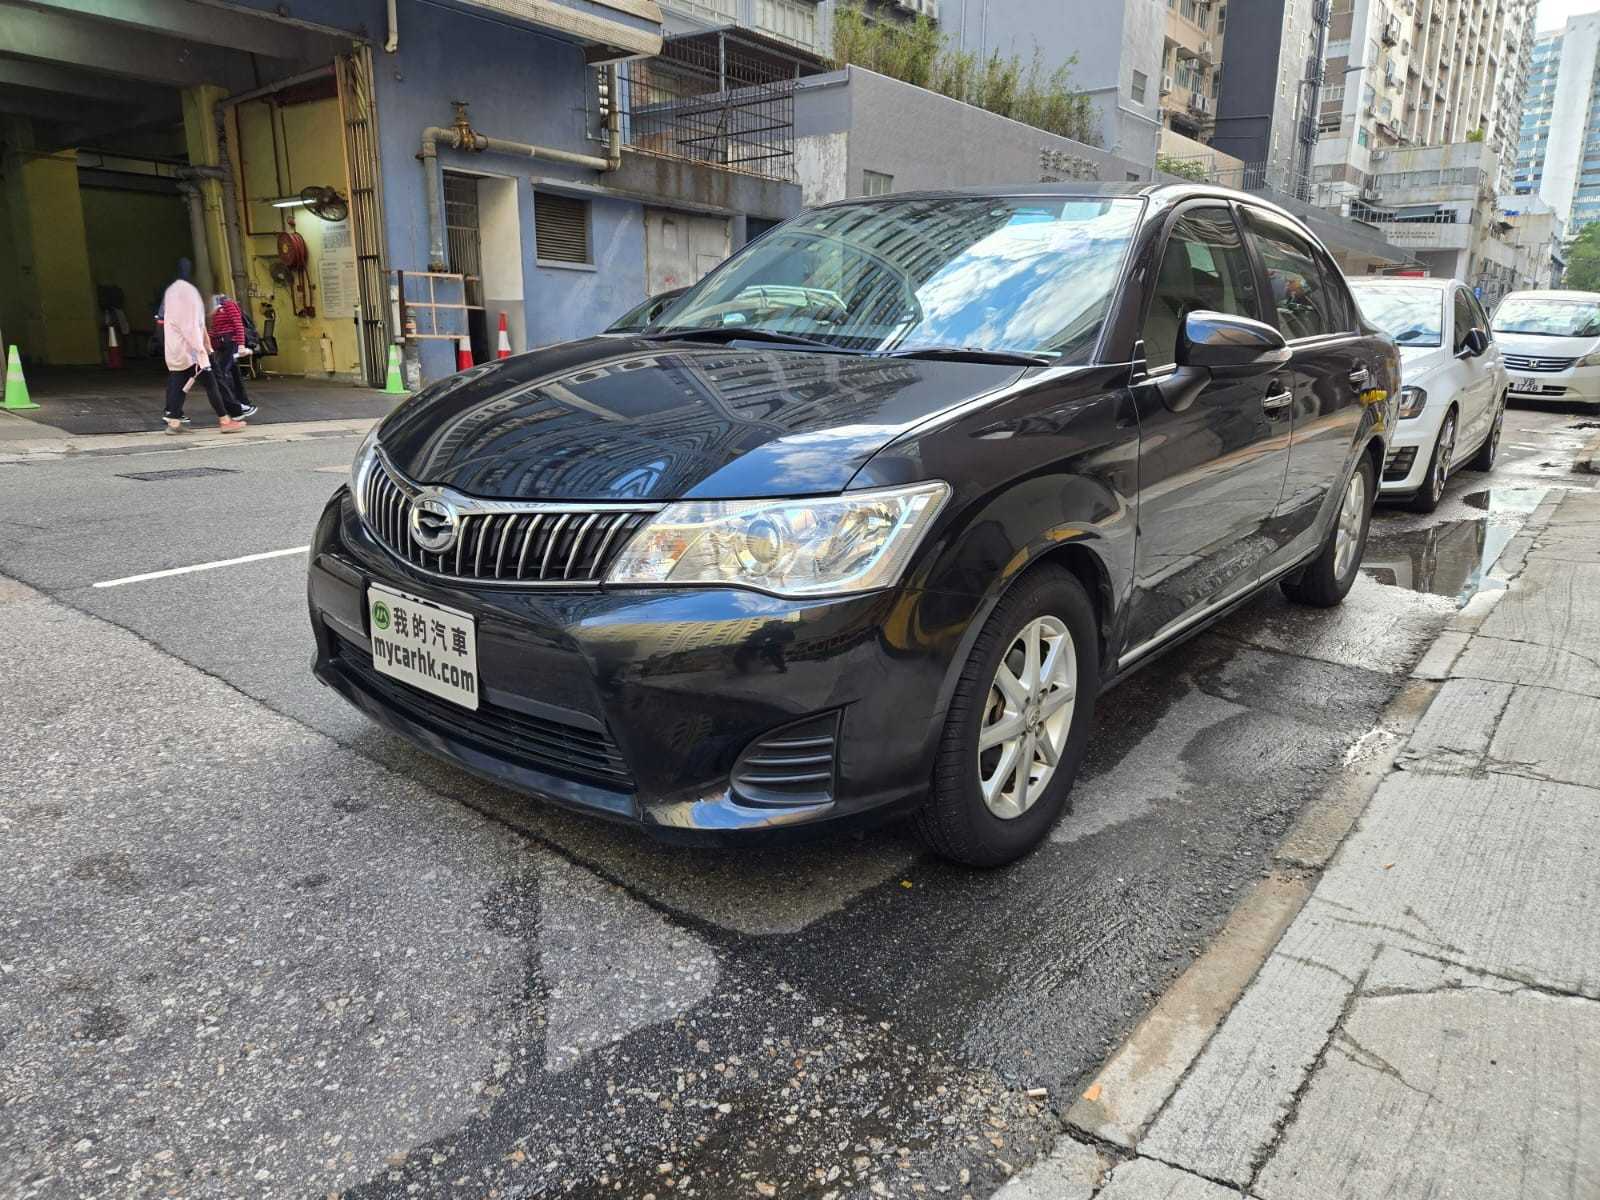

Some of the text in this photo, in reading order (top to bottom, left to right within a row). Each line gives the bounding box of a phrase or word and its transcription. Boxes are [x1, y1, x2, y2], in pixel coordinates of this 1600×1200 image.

[393, 607, 468, 657] 我的汽車
[374, 636, 475, 693] mycarhk.com
